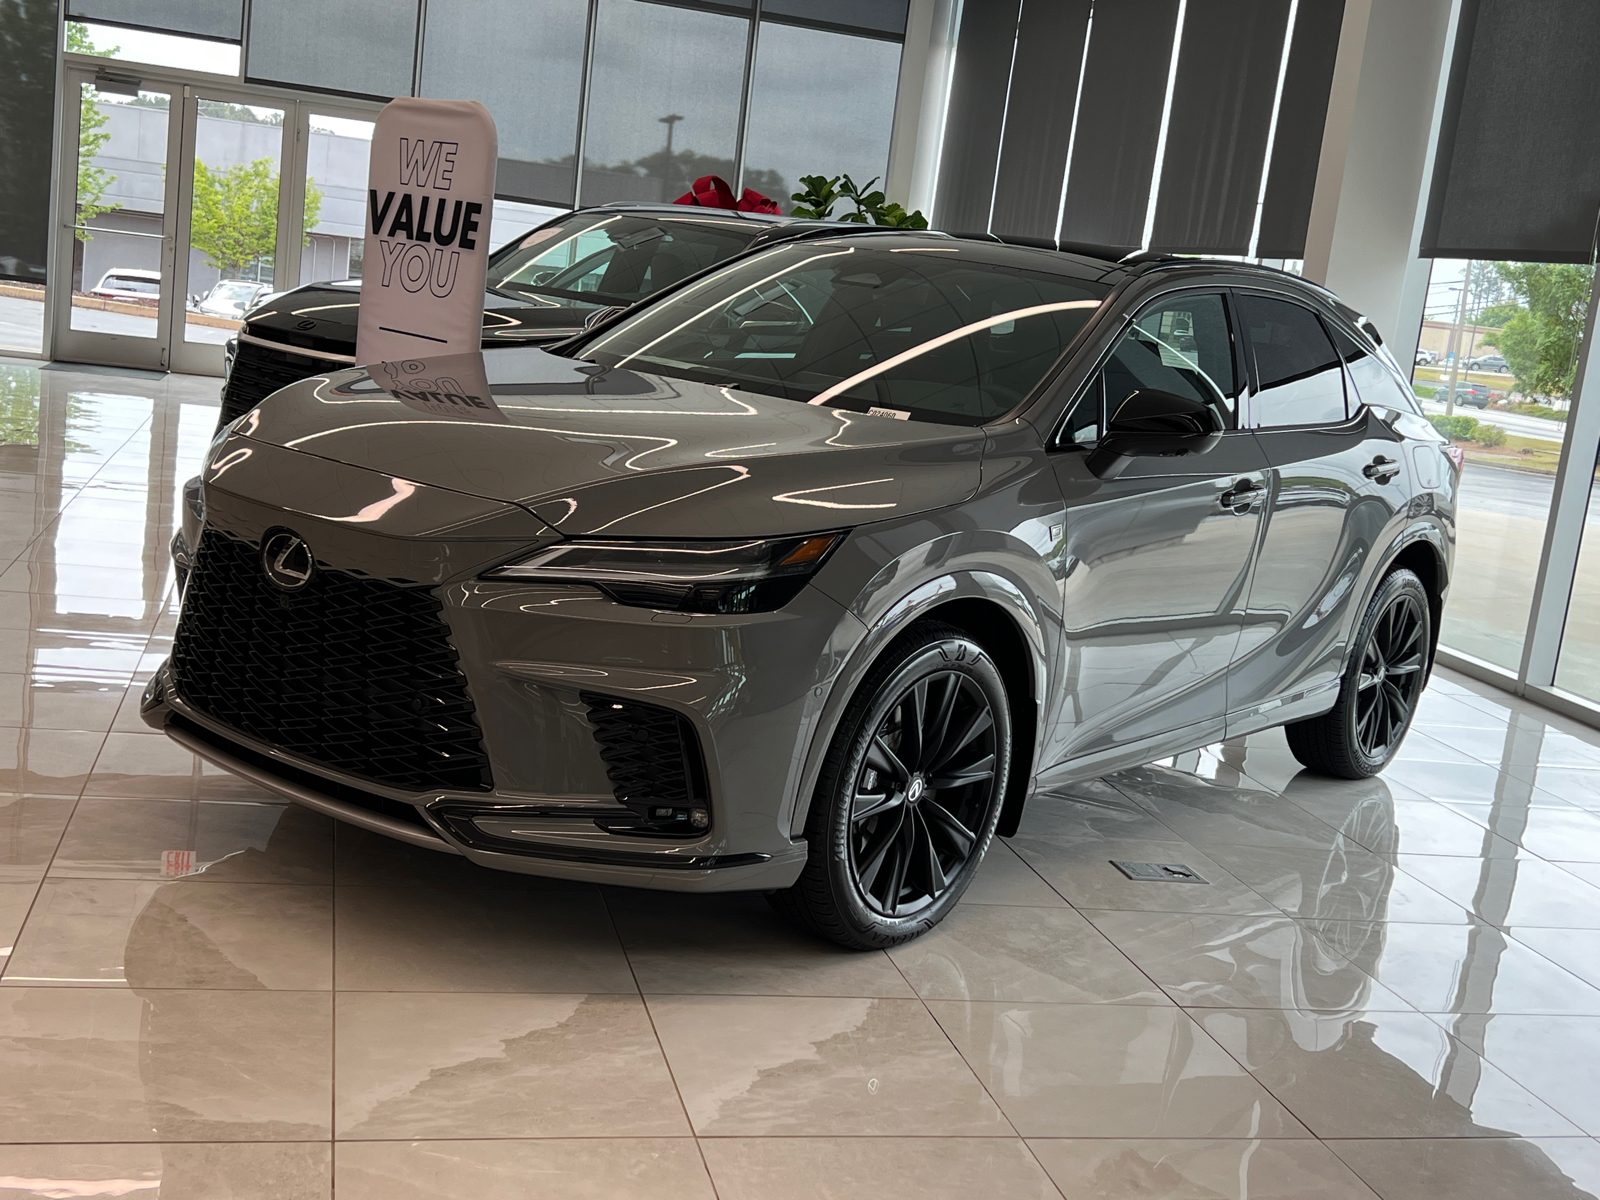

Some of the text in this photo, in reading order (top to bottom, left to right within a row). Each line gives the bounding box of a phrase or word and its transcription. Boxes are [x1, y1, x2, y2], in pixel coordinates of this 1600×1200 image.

[399, 137, 459, 191] WE
[369, 188, 483, 251] VALUE
[379, 239, 460, 298] YOU
